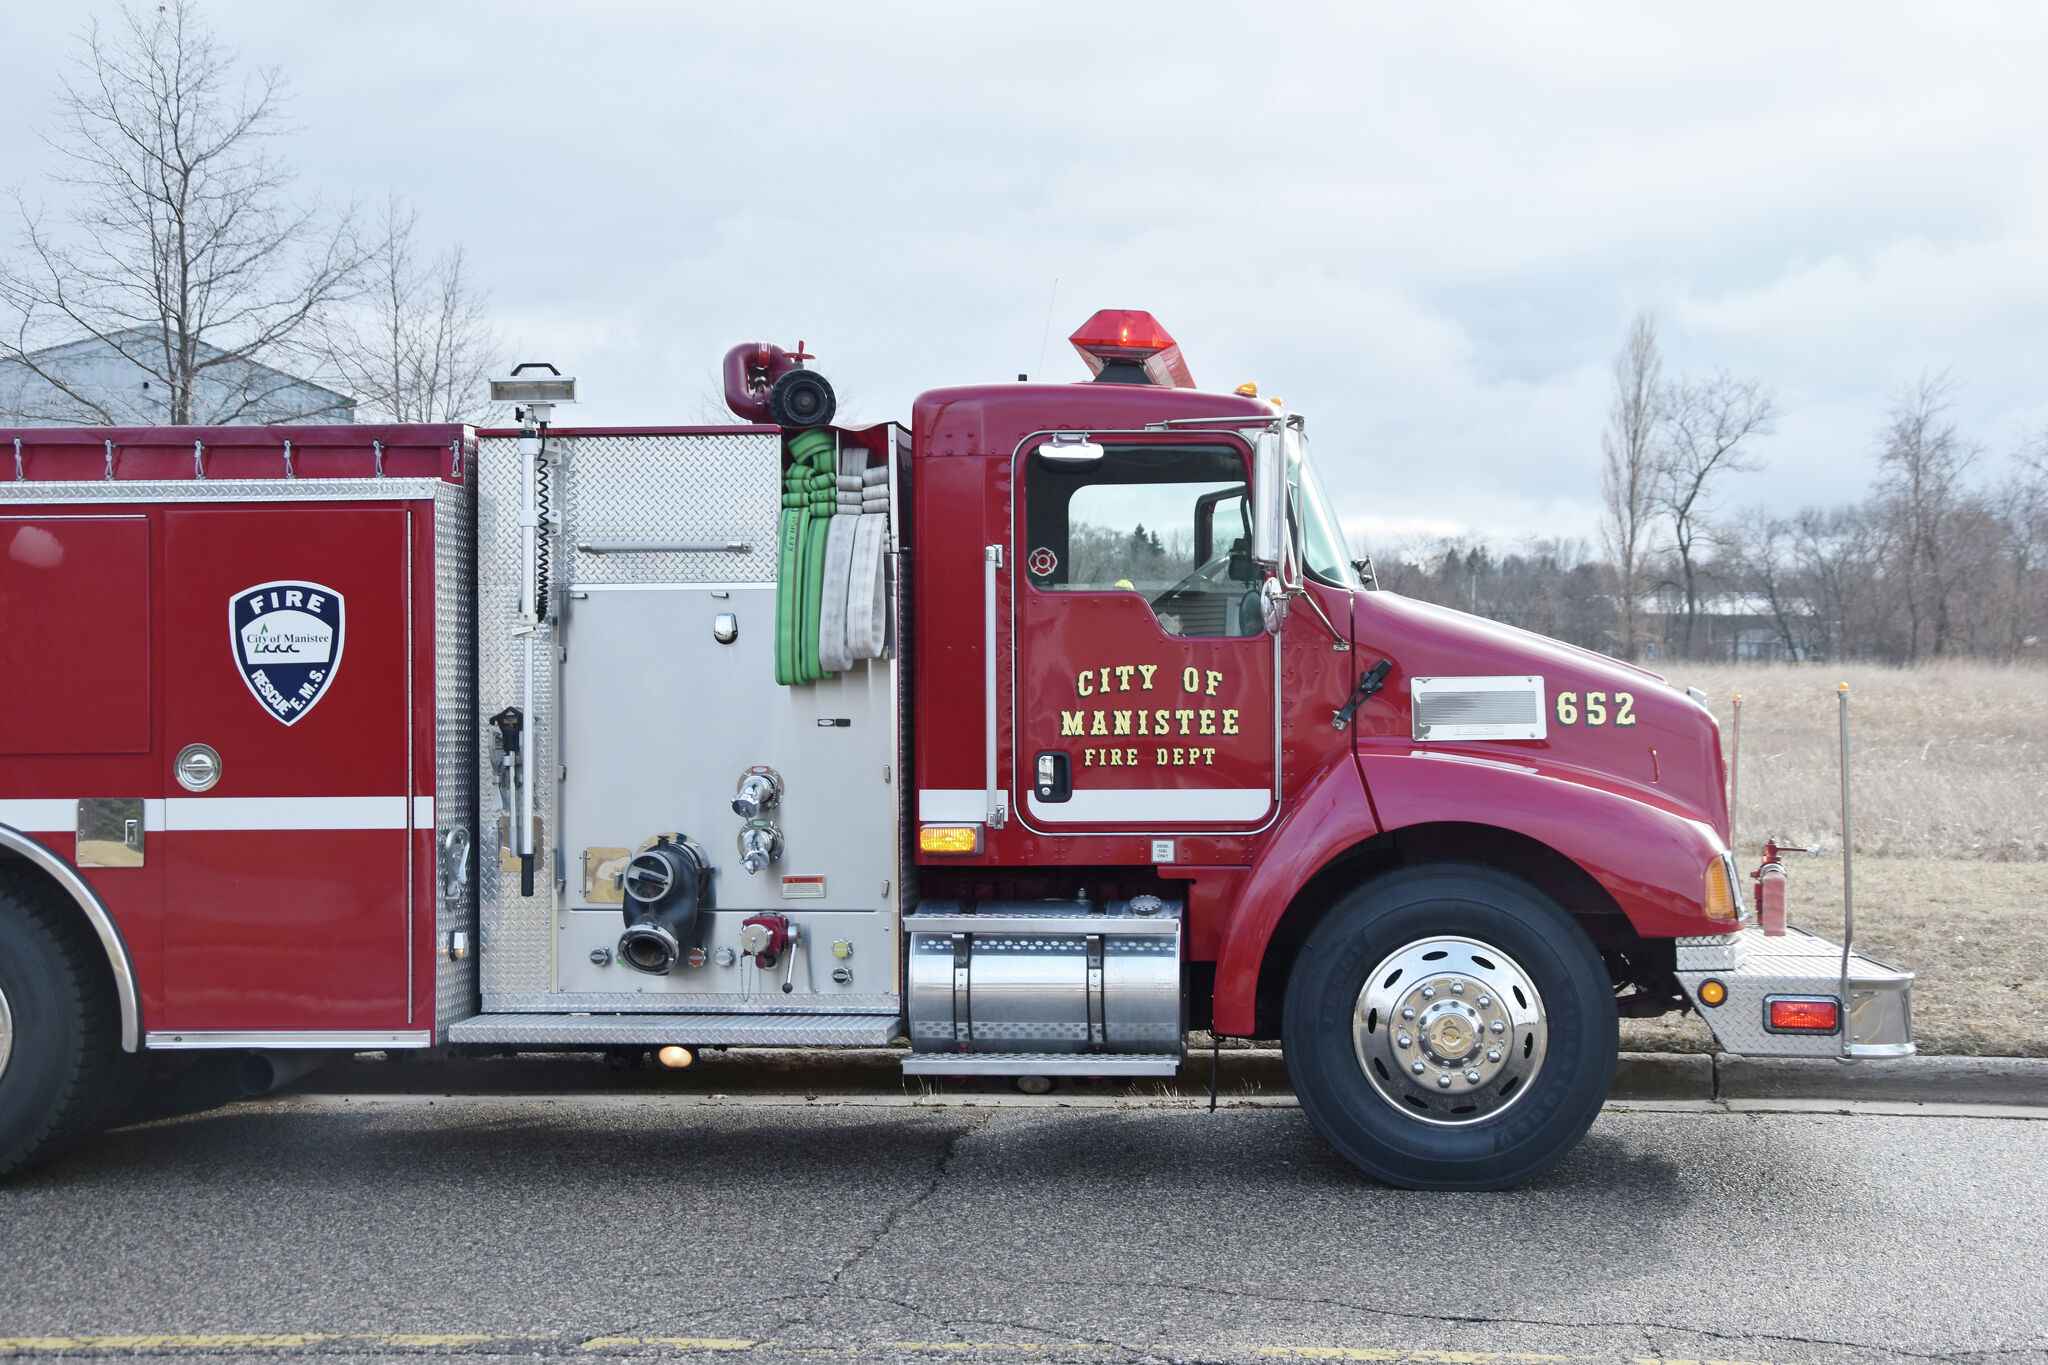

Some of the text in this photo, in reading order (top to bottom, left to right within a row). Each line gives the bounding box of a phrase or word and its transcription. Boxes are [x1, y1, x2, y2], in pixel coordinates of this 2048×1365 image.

[249, 590, 325, 615] FIRE
[247, 633, 329, 645] City of Manistee
[250, 668, 292, 716] RESCUE
[1077, 665, 1223, 697] CITY OF
[1556, 691, 1636, 726] 652
[1060, 709, 1239, 736] MANISTEE
[1084, 748, 1216, 766] FIRE DEPT
